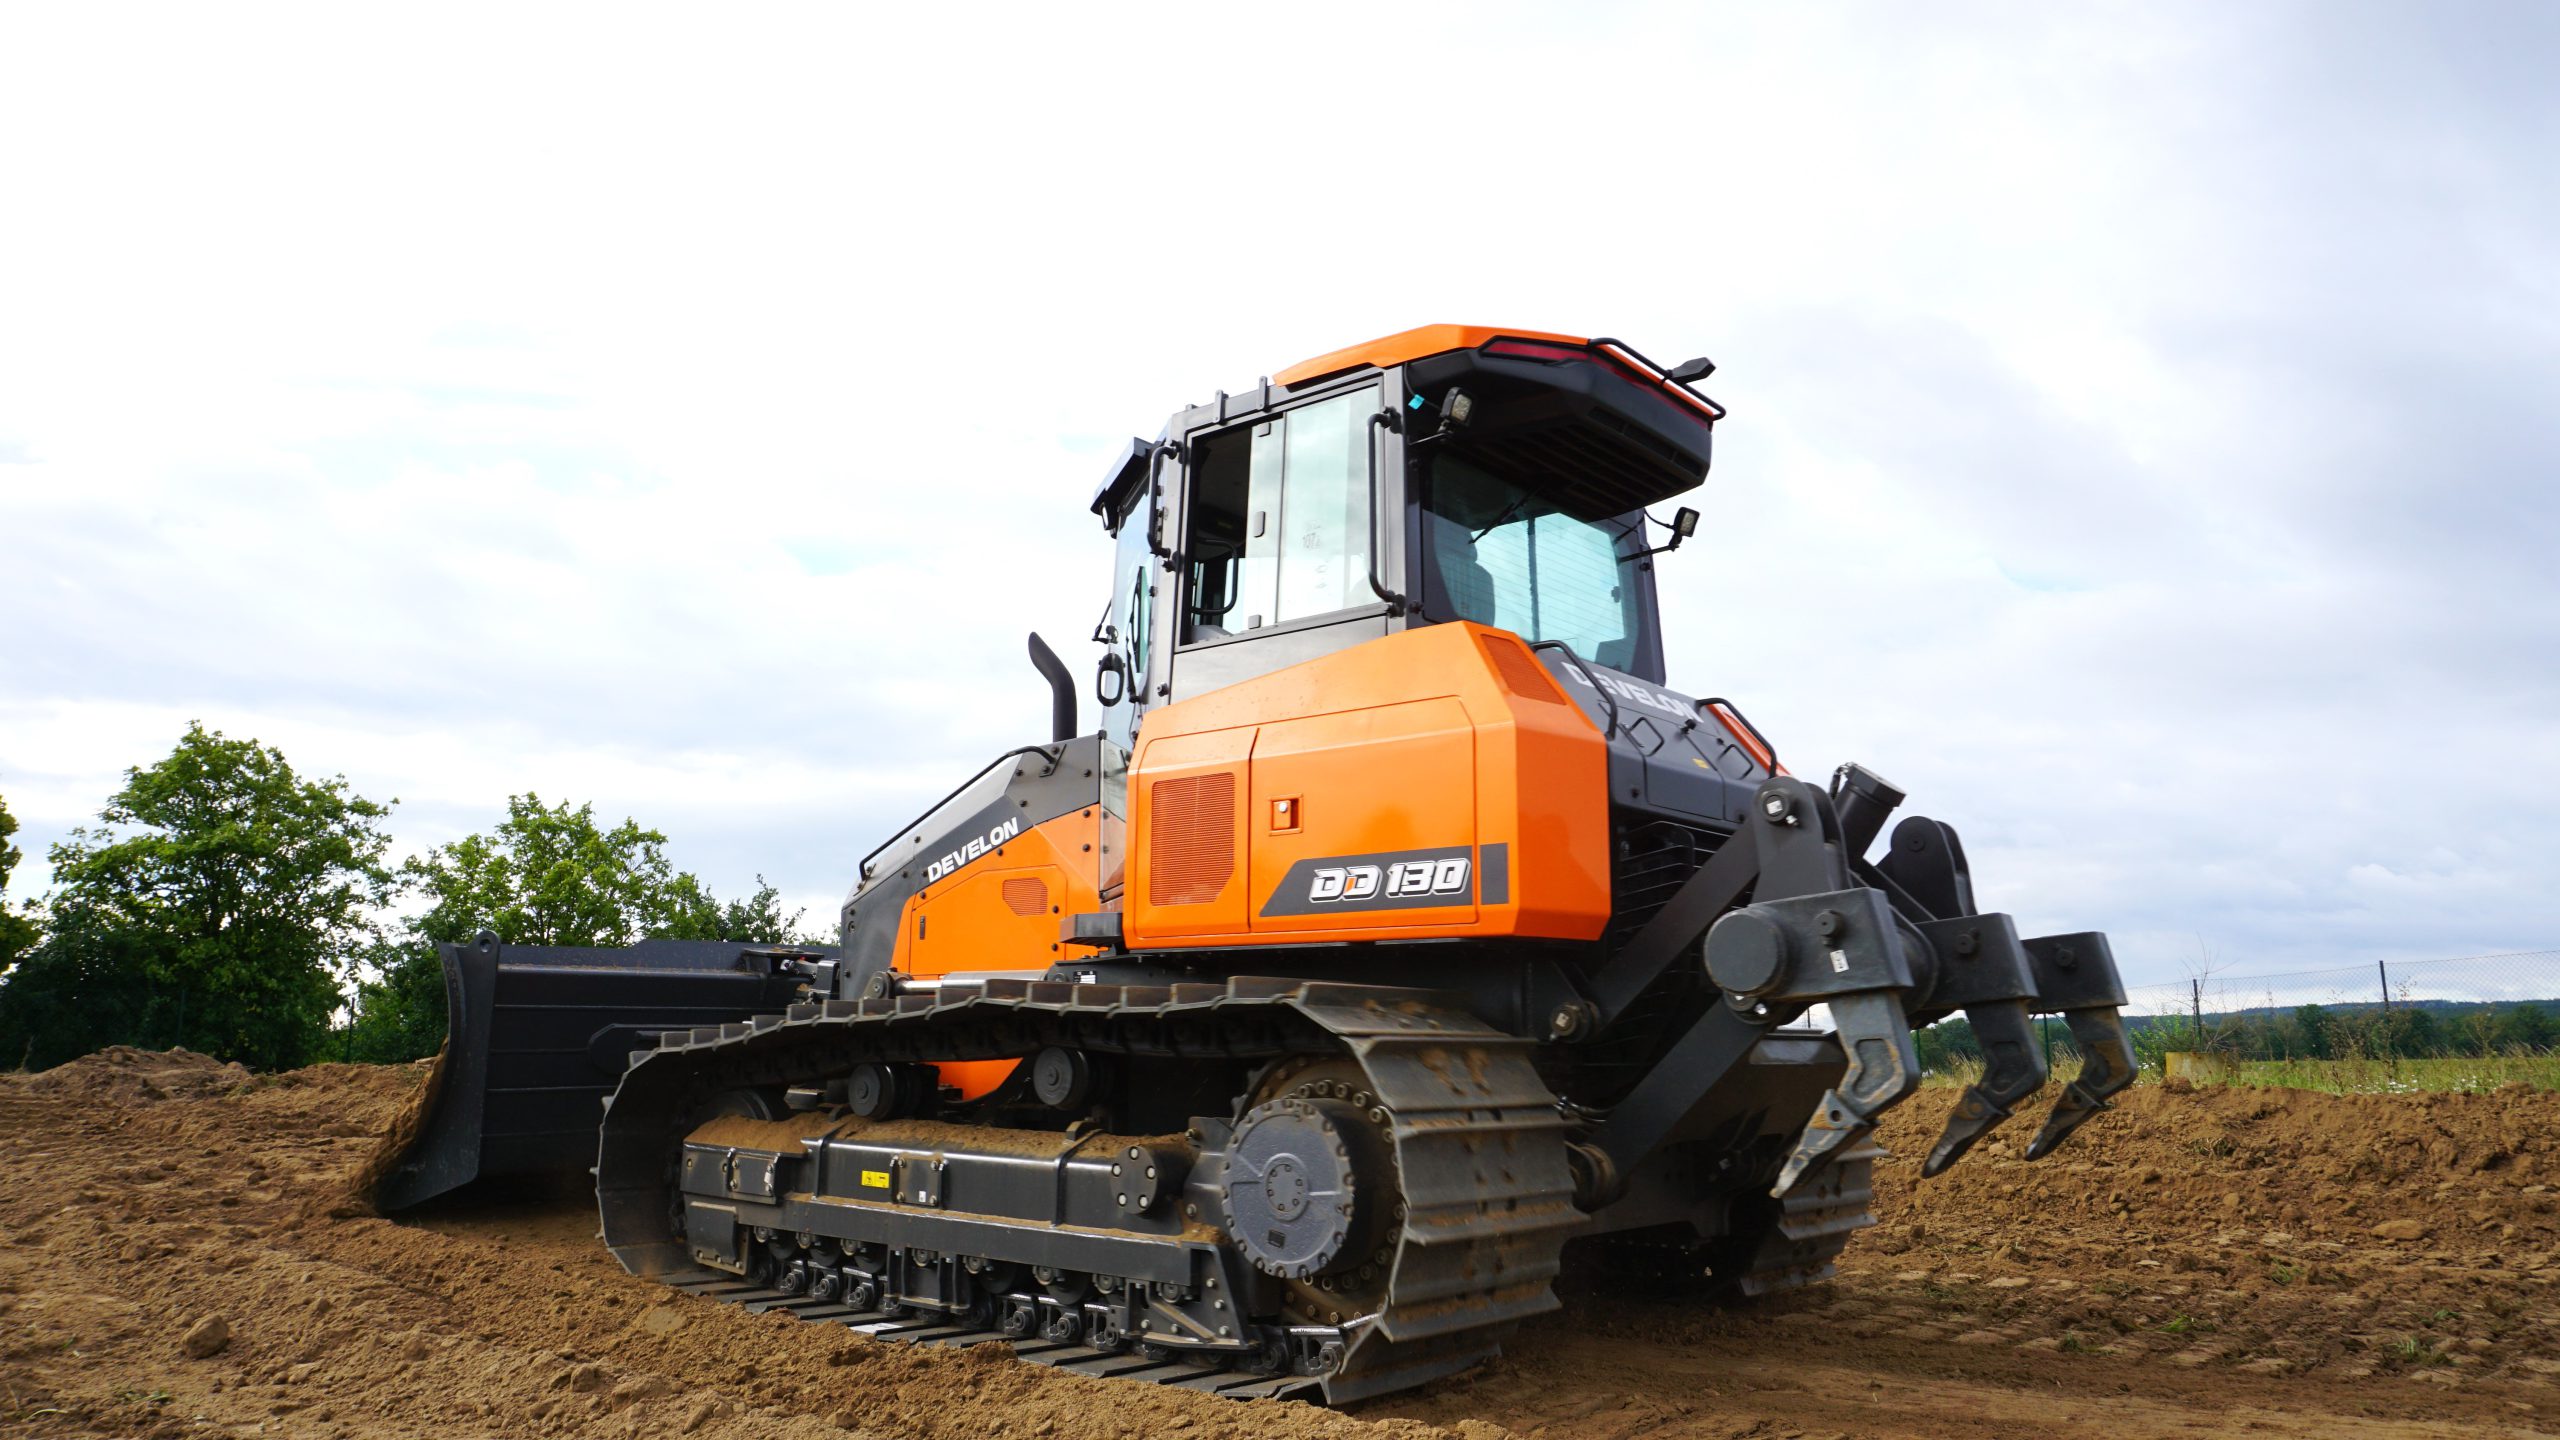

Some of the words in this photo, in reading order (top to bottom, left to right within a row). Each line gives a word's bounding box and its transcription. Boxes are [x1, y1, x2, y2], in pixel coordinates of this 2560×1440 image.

[927, 816, 1019, 883] DEVELON
[1308, 865, 1383, 903] DD
[1385, 857, 1472, 898] 130
